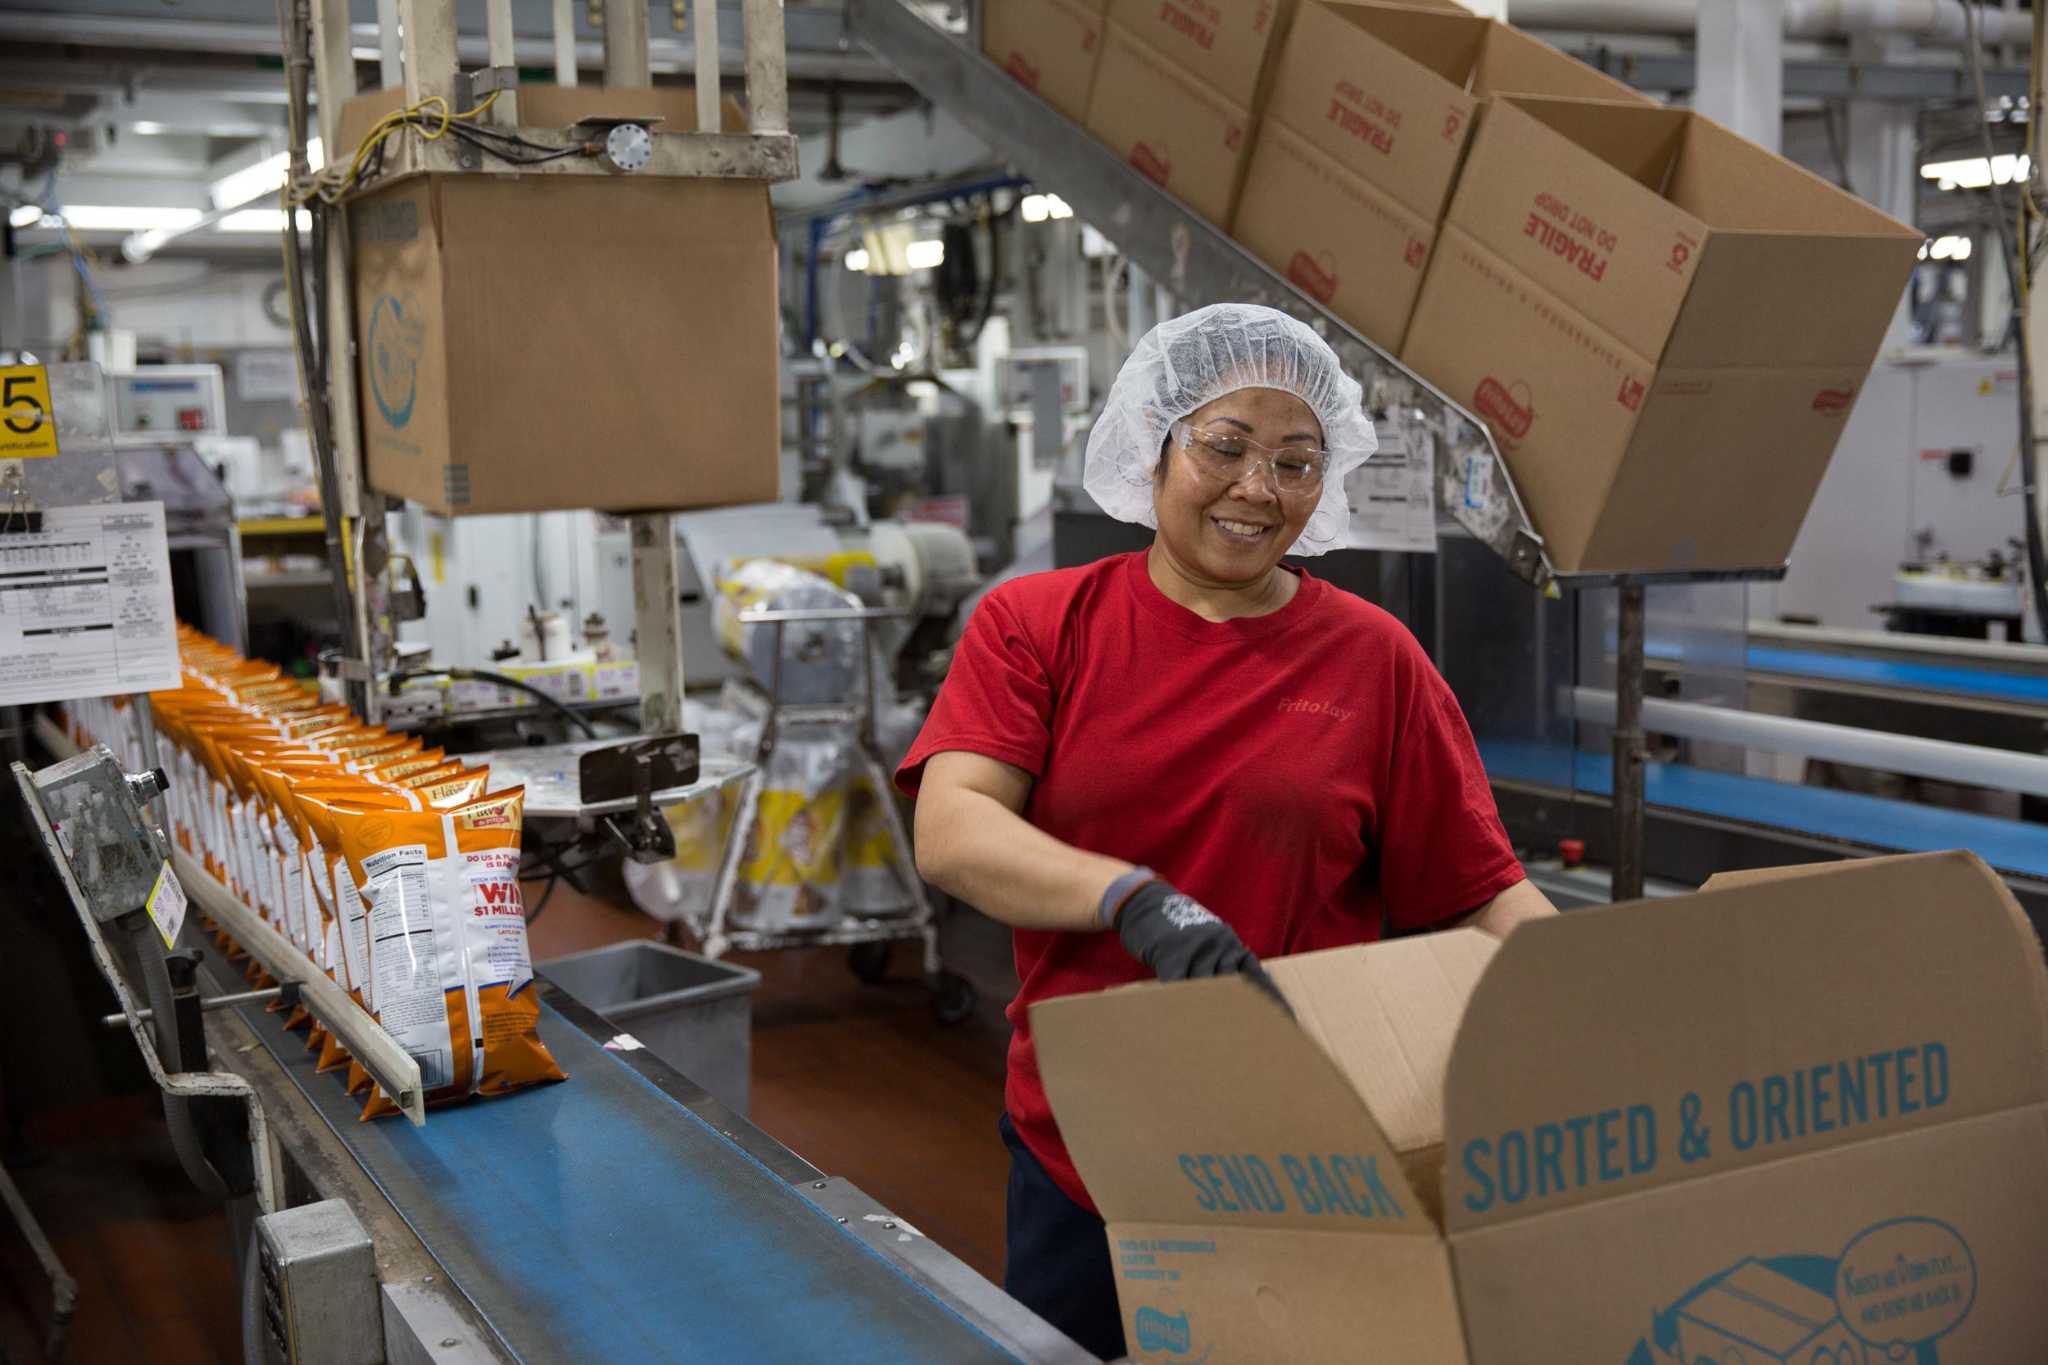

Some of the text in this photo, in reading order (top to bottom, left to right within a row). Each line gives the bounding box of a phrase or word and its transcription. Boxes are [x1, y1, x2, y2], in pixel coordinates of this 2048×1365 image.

[1523, 212, 1607, 281] FRAGILE
[1569, 212, 1595, 239] NOT
[1597, 229, 1617, 252] DO
[3, 376, 44, 434] 5
[474, 906, 489, 916] $1
[1462, 1042, 1950, 1212] SORTED & ORIENTED
[1178, 1153, 1406, 1217] SEND BACK
